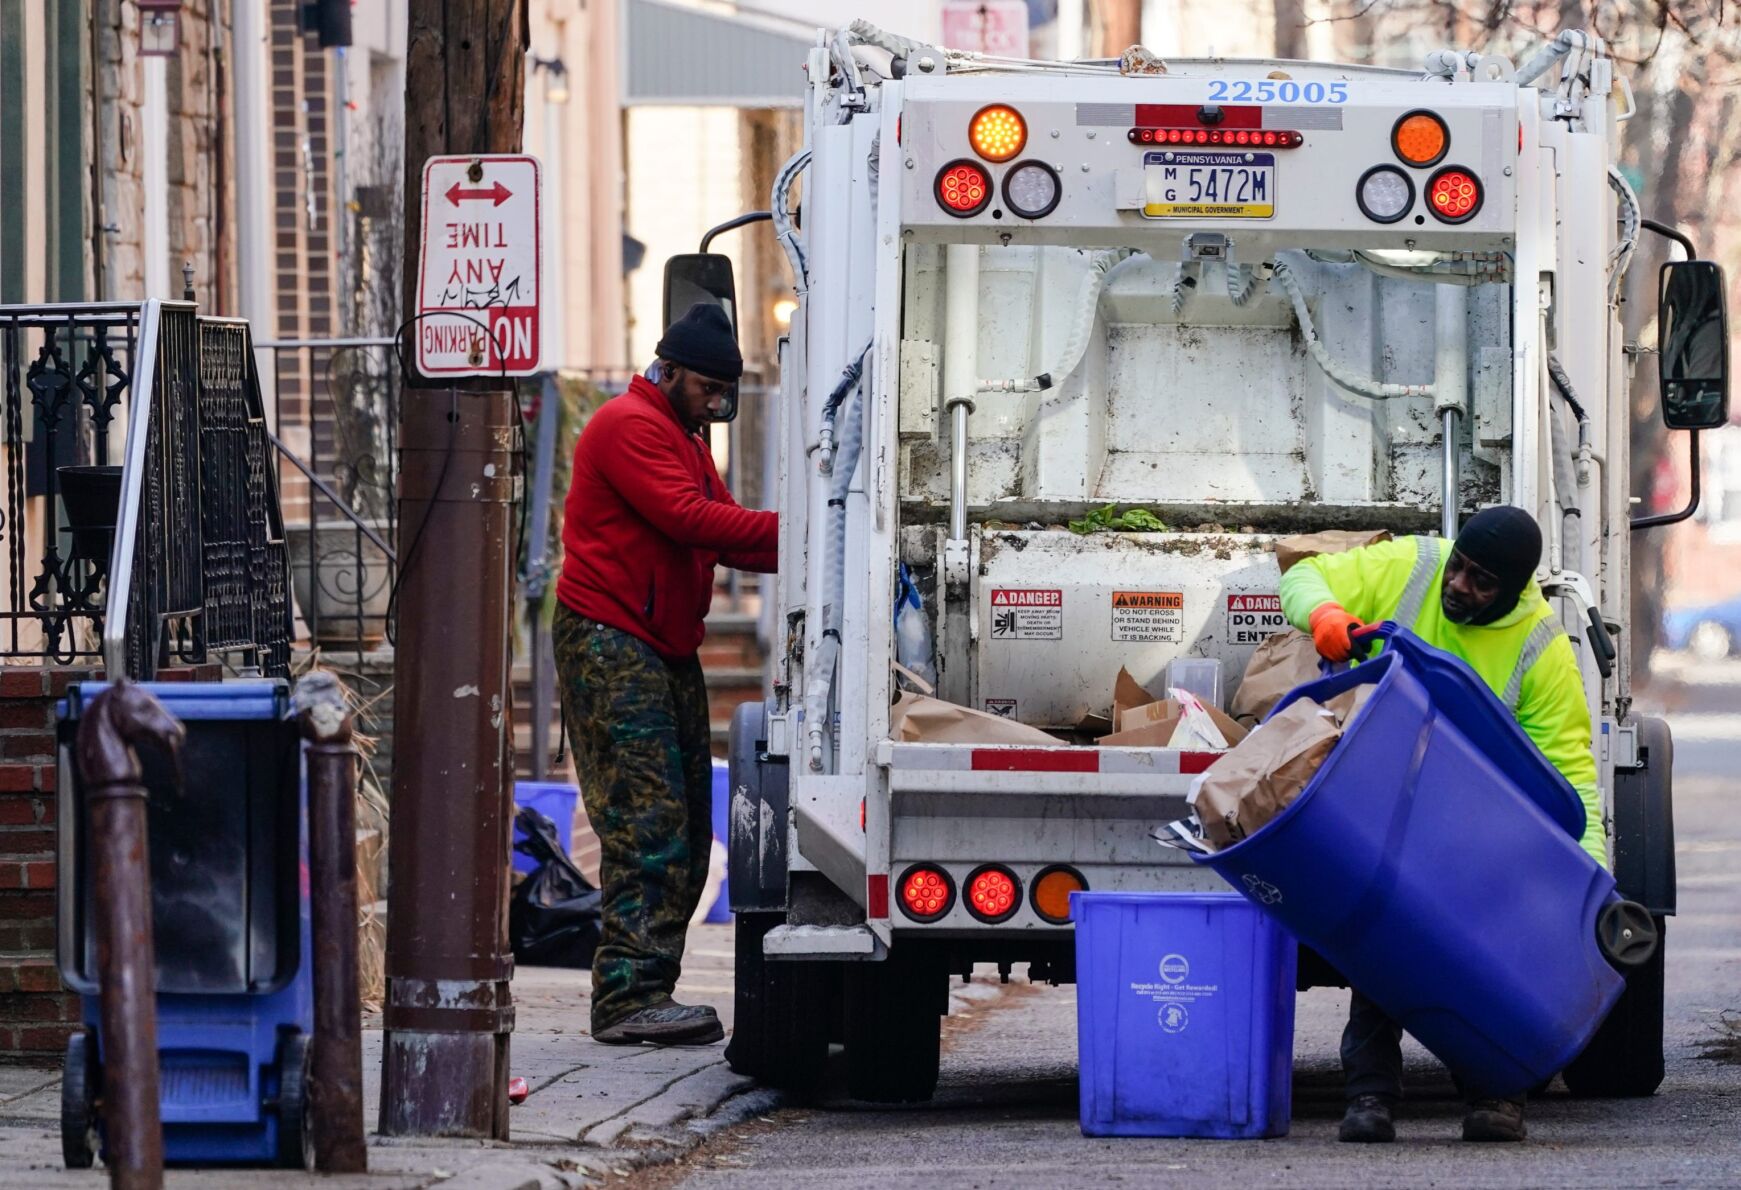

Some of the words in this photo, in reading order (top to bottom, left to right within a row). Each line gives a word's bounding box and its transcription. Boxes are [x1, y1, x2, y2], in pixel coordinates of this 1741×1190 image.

[1208, 80, 1348, 103] 225005
[1175, 154, 1243, 164] PENNSYLVANIA
[1189, 168, 1266, 202] 5472M
[1172, 206, 1203, 214] MUNICIPAL
[1204, 206, 1244, 214] GOVERNMENT
[446, 222, 508, 249] TIME
[448, 258, 505, 285] ANY
[425, 324, 486, 355] PARKING
[493, 315, 532, 360] NO
[1009, 592, 1060, 604] DANGER
[1129, 596, 1180, 607] WARNING
[1246, 597, 1280, 610] DANG
[1233, 614, 1256, 626] DO
[1261, 614, 1291, 626] NO
